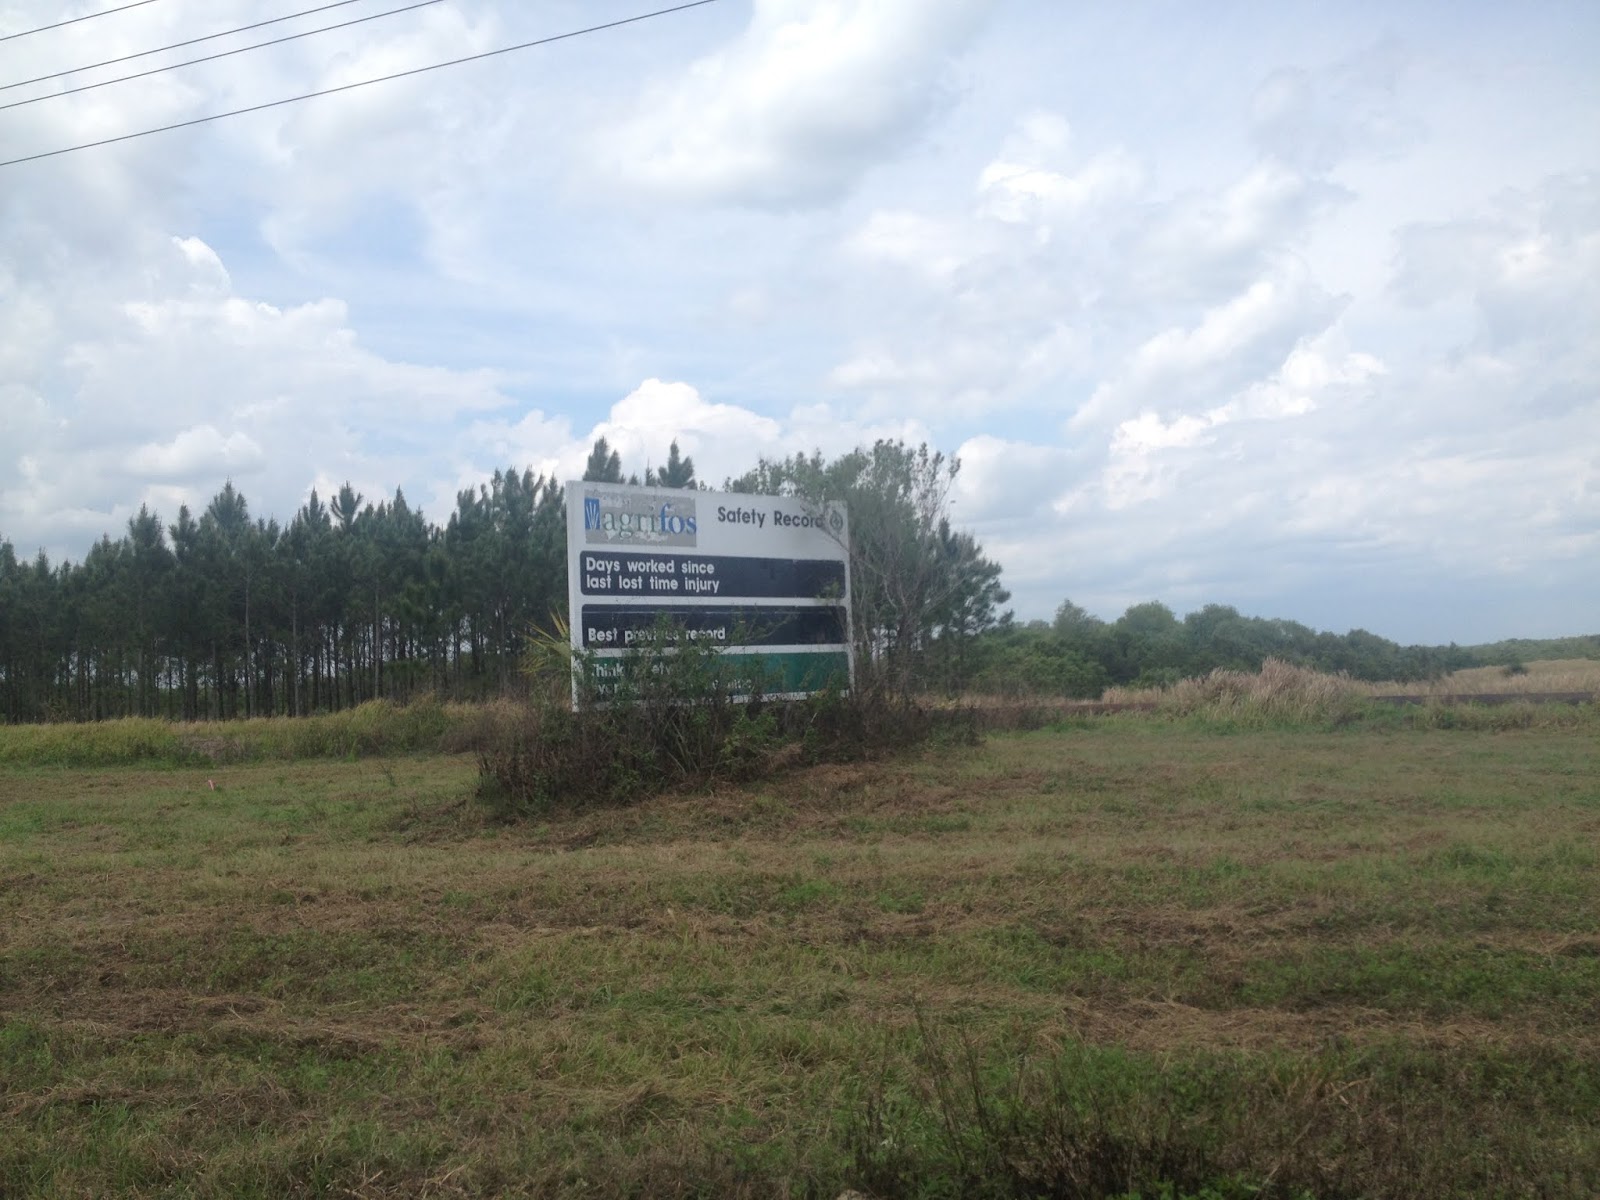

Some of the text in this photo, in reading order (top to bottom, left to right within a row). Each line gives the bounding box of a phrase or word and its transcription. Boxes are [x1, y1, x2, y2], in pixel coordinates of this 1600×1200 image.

[717, 506, 824, 528] Safety Record
[585, 557, 715, 574] Days worked since
[586, 574, 720, 593] last lost time injury
[587, 627, 618, 642] Best
[624, 628, 680, 644] previus
